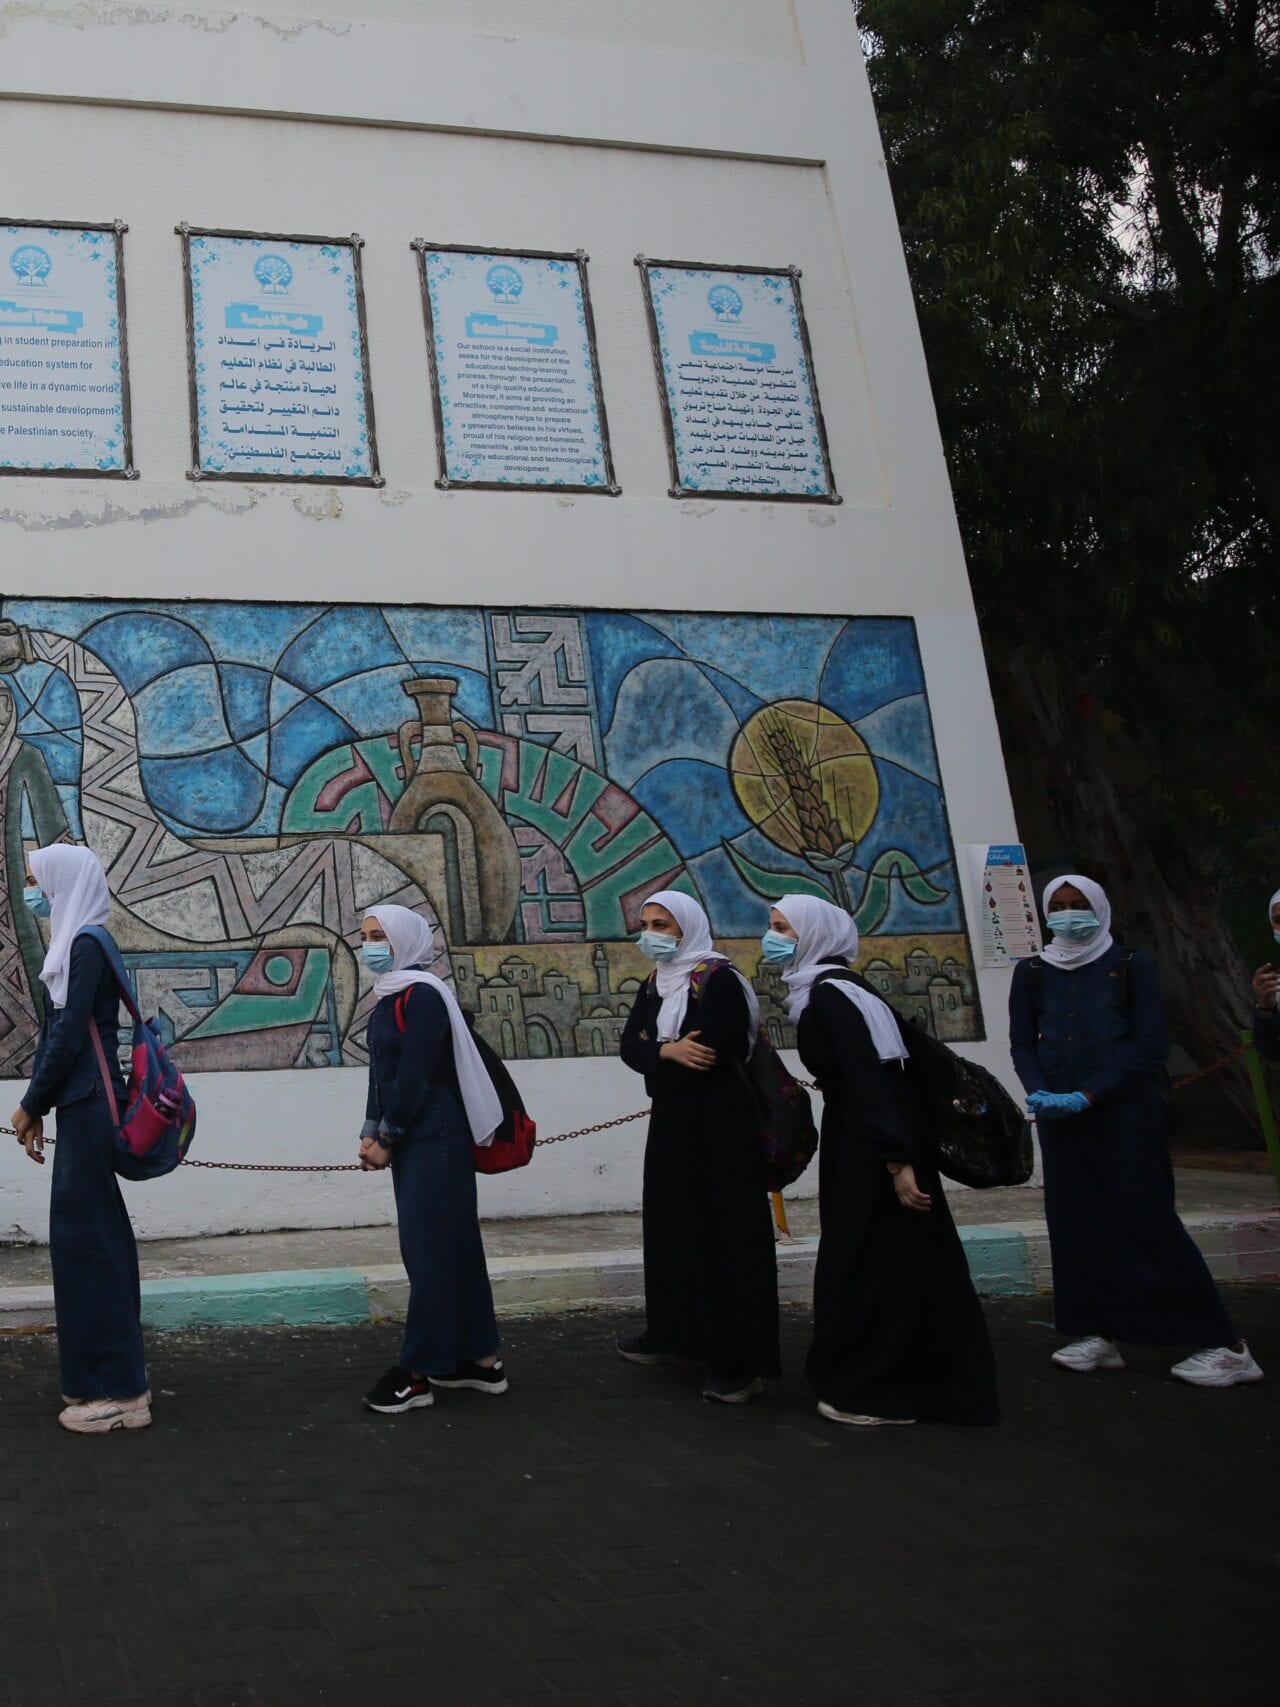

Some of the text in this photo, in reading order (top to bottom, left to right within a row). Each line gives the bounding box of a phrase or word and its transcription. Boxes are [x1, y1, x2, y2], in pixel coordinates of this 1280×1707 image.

[5, 336, 12, 345] in
[15, 337, 49, 346] student
[51, 339, 102, 350] preparation
[105, 340, 113, 349] in
[264, 337, 284, 351] في
[288, 337, 335, 352] الريادة
[510, 345, 531, 353] social
[0, 357, 43, 368] education
[45, 360, 77, 370] system
[80, 360, 93, 370] for
[221, 356, 335, 374] الطالبة في نظام التعليم
[505, 355, 549, 364] development
[507, 364, 568, 375] teaching-learning
[489, 374, 517, 382] through
[533, 376, 576, 385] presentation
[14, 380, 28, 389] life
[30, 381, 38, 390] in
[48, 382, 87, 393] dynamic
[89, 384, 114, 393] world
[220, 378, 335, 396] لحياة منتجة في عالم
[486, 383, 502, 391] high
[503, 385, 526, 393] quality
[532, 396, 565, 404] providing
[730, 390, 746, 399] خلال
[750, 393, 759, 401] من
[1, 403, 54, 413] sustainable
[56, 405, 114, 416] development
[220, 399, 263, 414] لتحقيق
[267, 402, 308, 417] التغيير
[490, 404, 532, 413] competitive
[548, 406, 589, 414] educational
[472, 413, 514, 421] atmosphere
[515, 415, 534, 423] helps
[8, 426, 59, 436] Palestinian
[61, 428, 96, 438] society.
[222, 421, 339, 440] التنمية المستدامة
[507, 434, 533, 442] religion
[291, 447, 340, 463] للمجتمع
[488, 454, 529, 462] educational
[545, 456, 592, 465] technological
